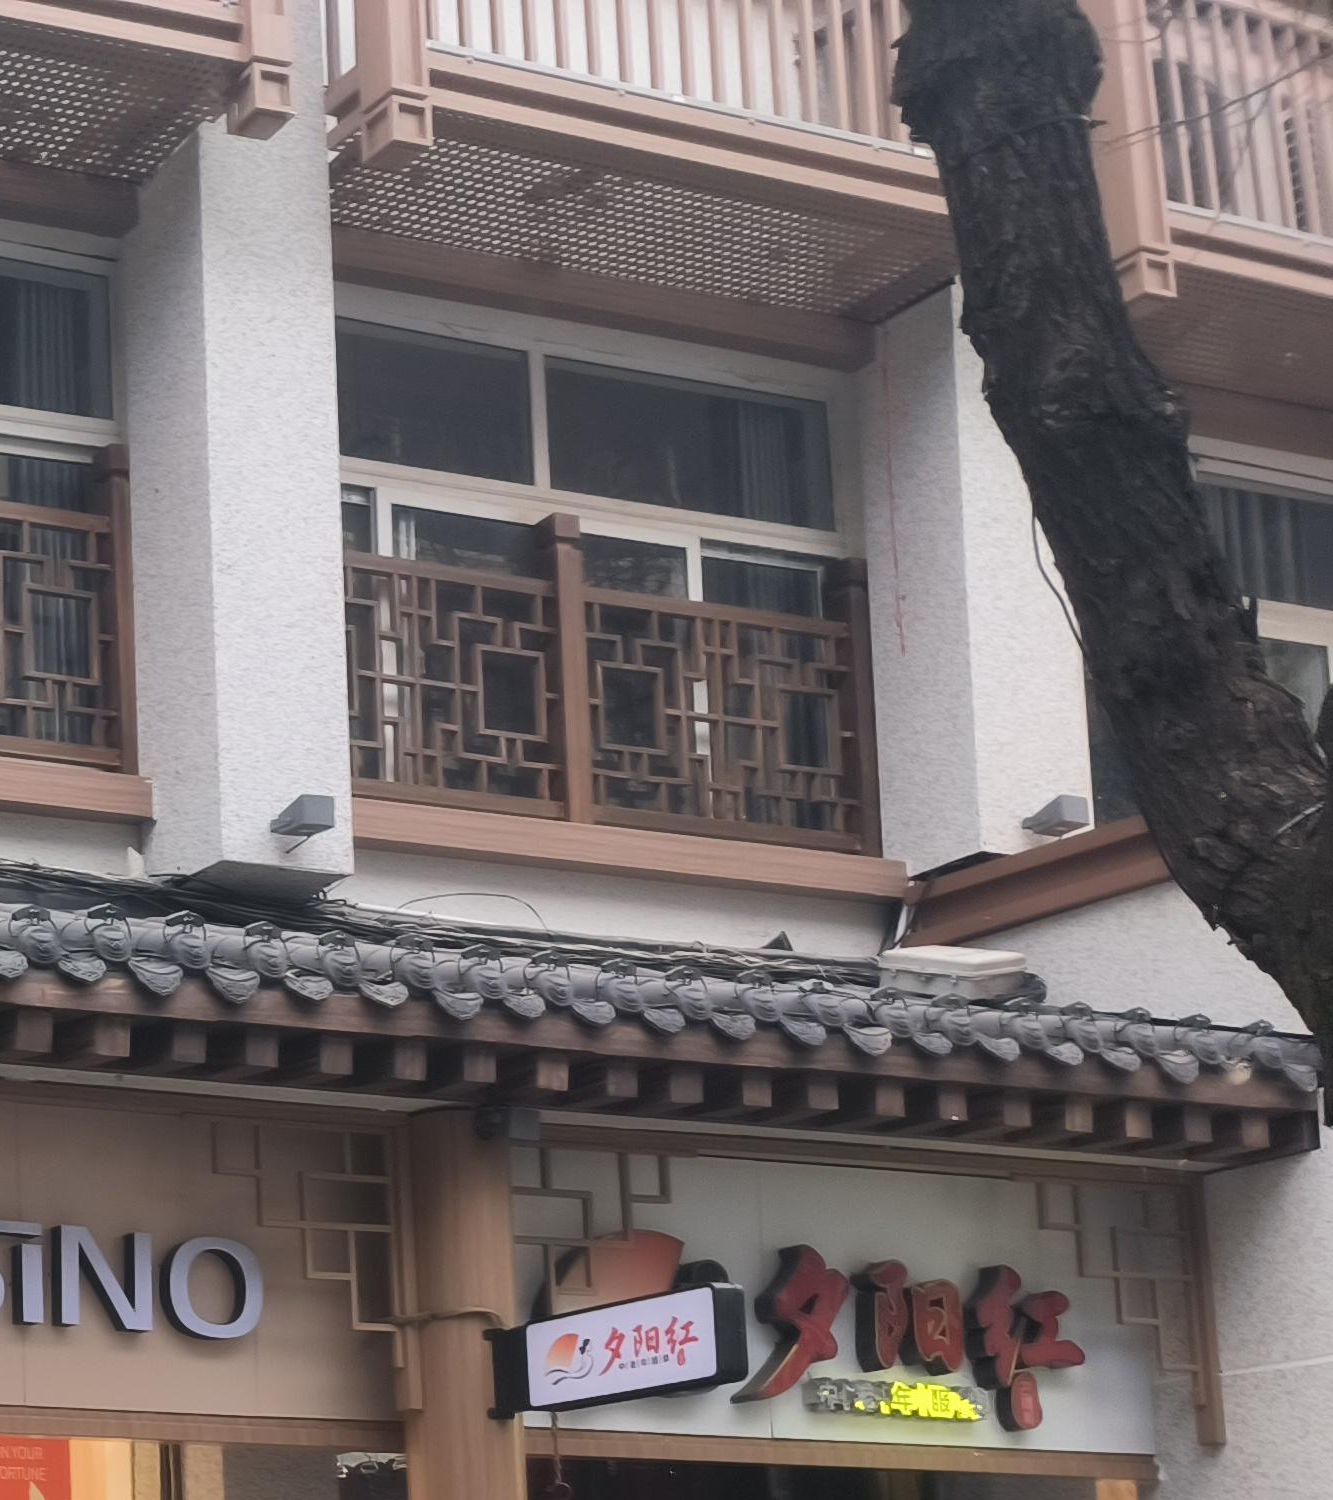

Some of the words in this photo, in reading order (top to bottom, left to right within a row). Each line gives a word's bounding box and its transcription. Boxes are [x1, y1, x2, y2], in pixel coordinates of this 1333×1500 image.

[600, 1316, 699, 1376] 夕阳红
[730, 1244, 1086, 1403] 夕阳红
